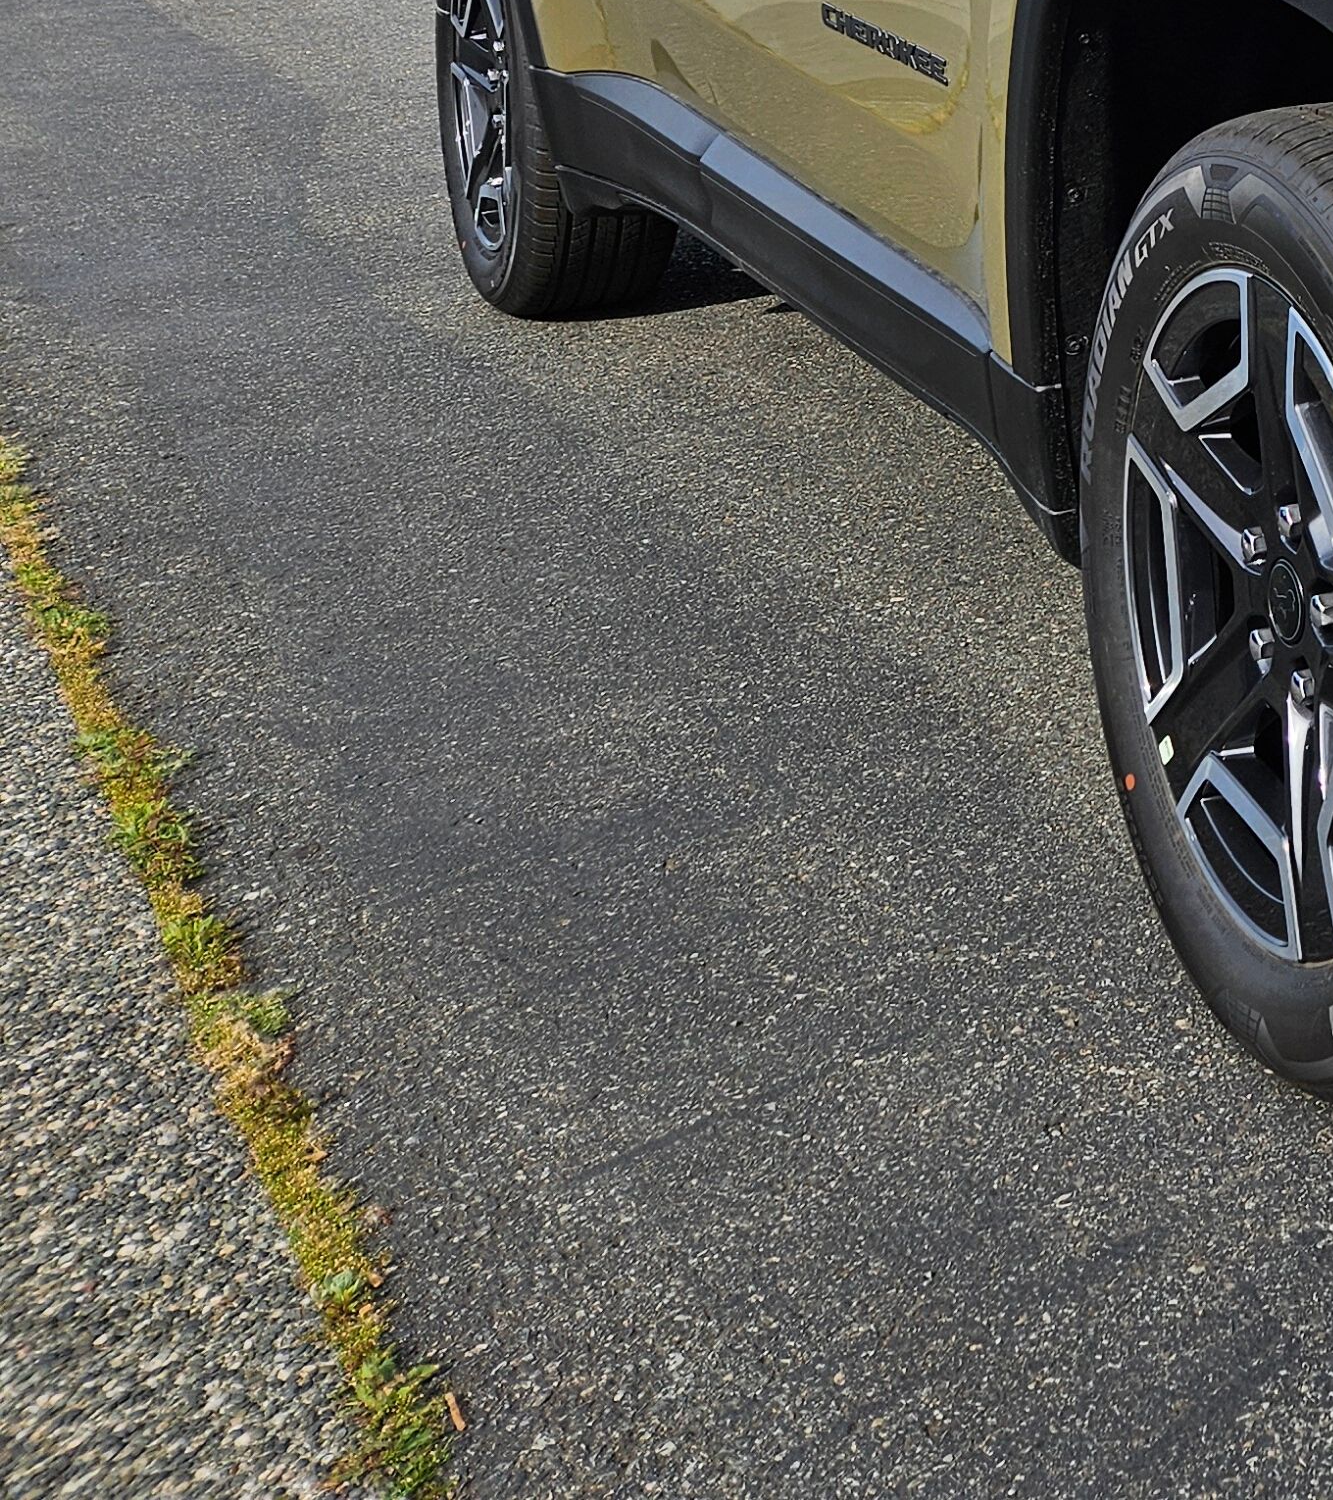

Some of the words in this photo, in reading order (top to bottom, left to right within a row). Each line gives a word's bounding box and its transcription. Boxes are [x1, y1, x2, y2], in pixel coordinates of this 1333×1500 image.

[821, 0, 950, 87] CHEROKEE
[1080, 249, 1134, 486] ROADIAN
[1134, 207, 1175, 269] GTX
